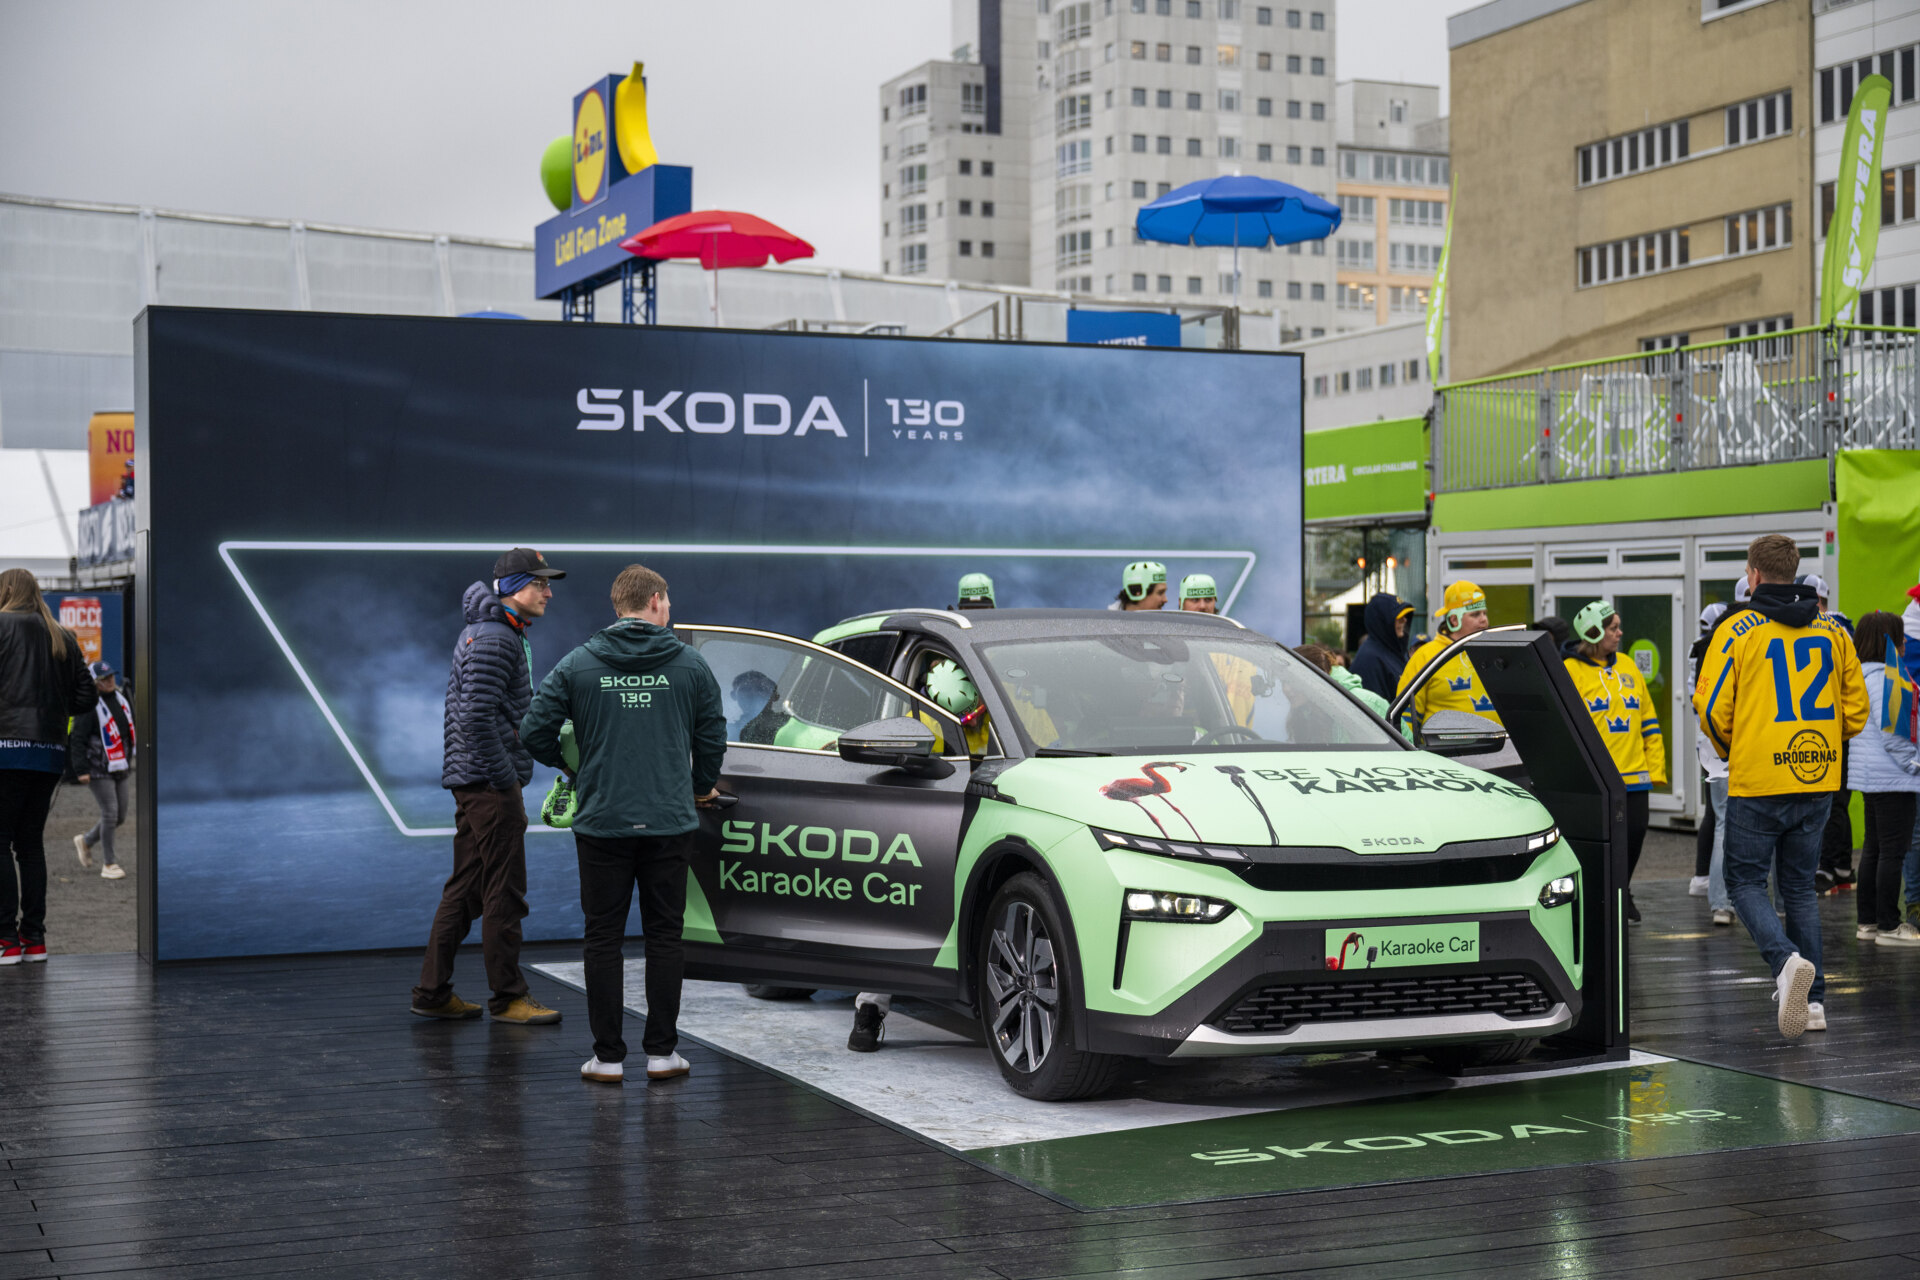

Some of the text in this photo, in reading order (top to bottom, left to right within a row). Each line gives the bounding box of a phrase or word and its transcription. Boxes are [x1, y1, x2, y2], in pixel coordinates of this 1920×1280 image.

[555, 228, 576, 267] Lidl
[598, 213, 627, 247] Zone
[885, 398, 965, 427] 130
[893, 430, 964, 441] YEARS
[1765, 636, 1835, 722] 12
[619, 692, 652, 703] 130
[1773, 749, 1837, 766] BRÖDERNAS
[1252, 766, 1475, 781] BE MORE
[1288, 778, 1540, 802] KARAOKE
[719, 860, 923, 906] Karaoke Car
[1381, 936, 1475, 956] Karaoke Car
